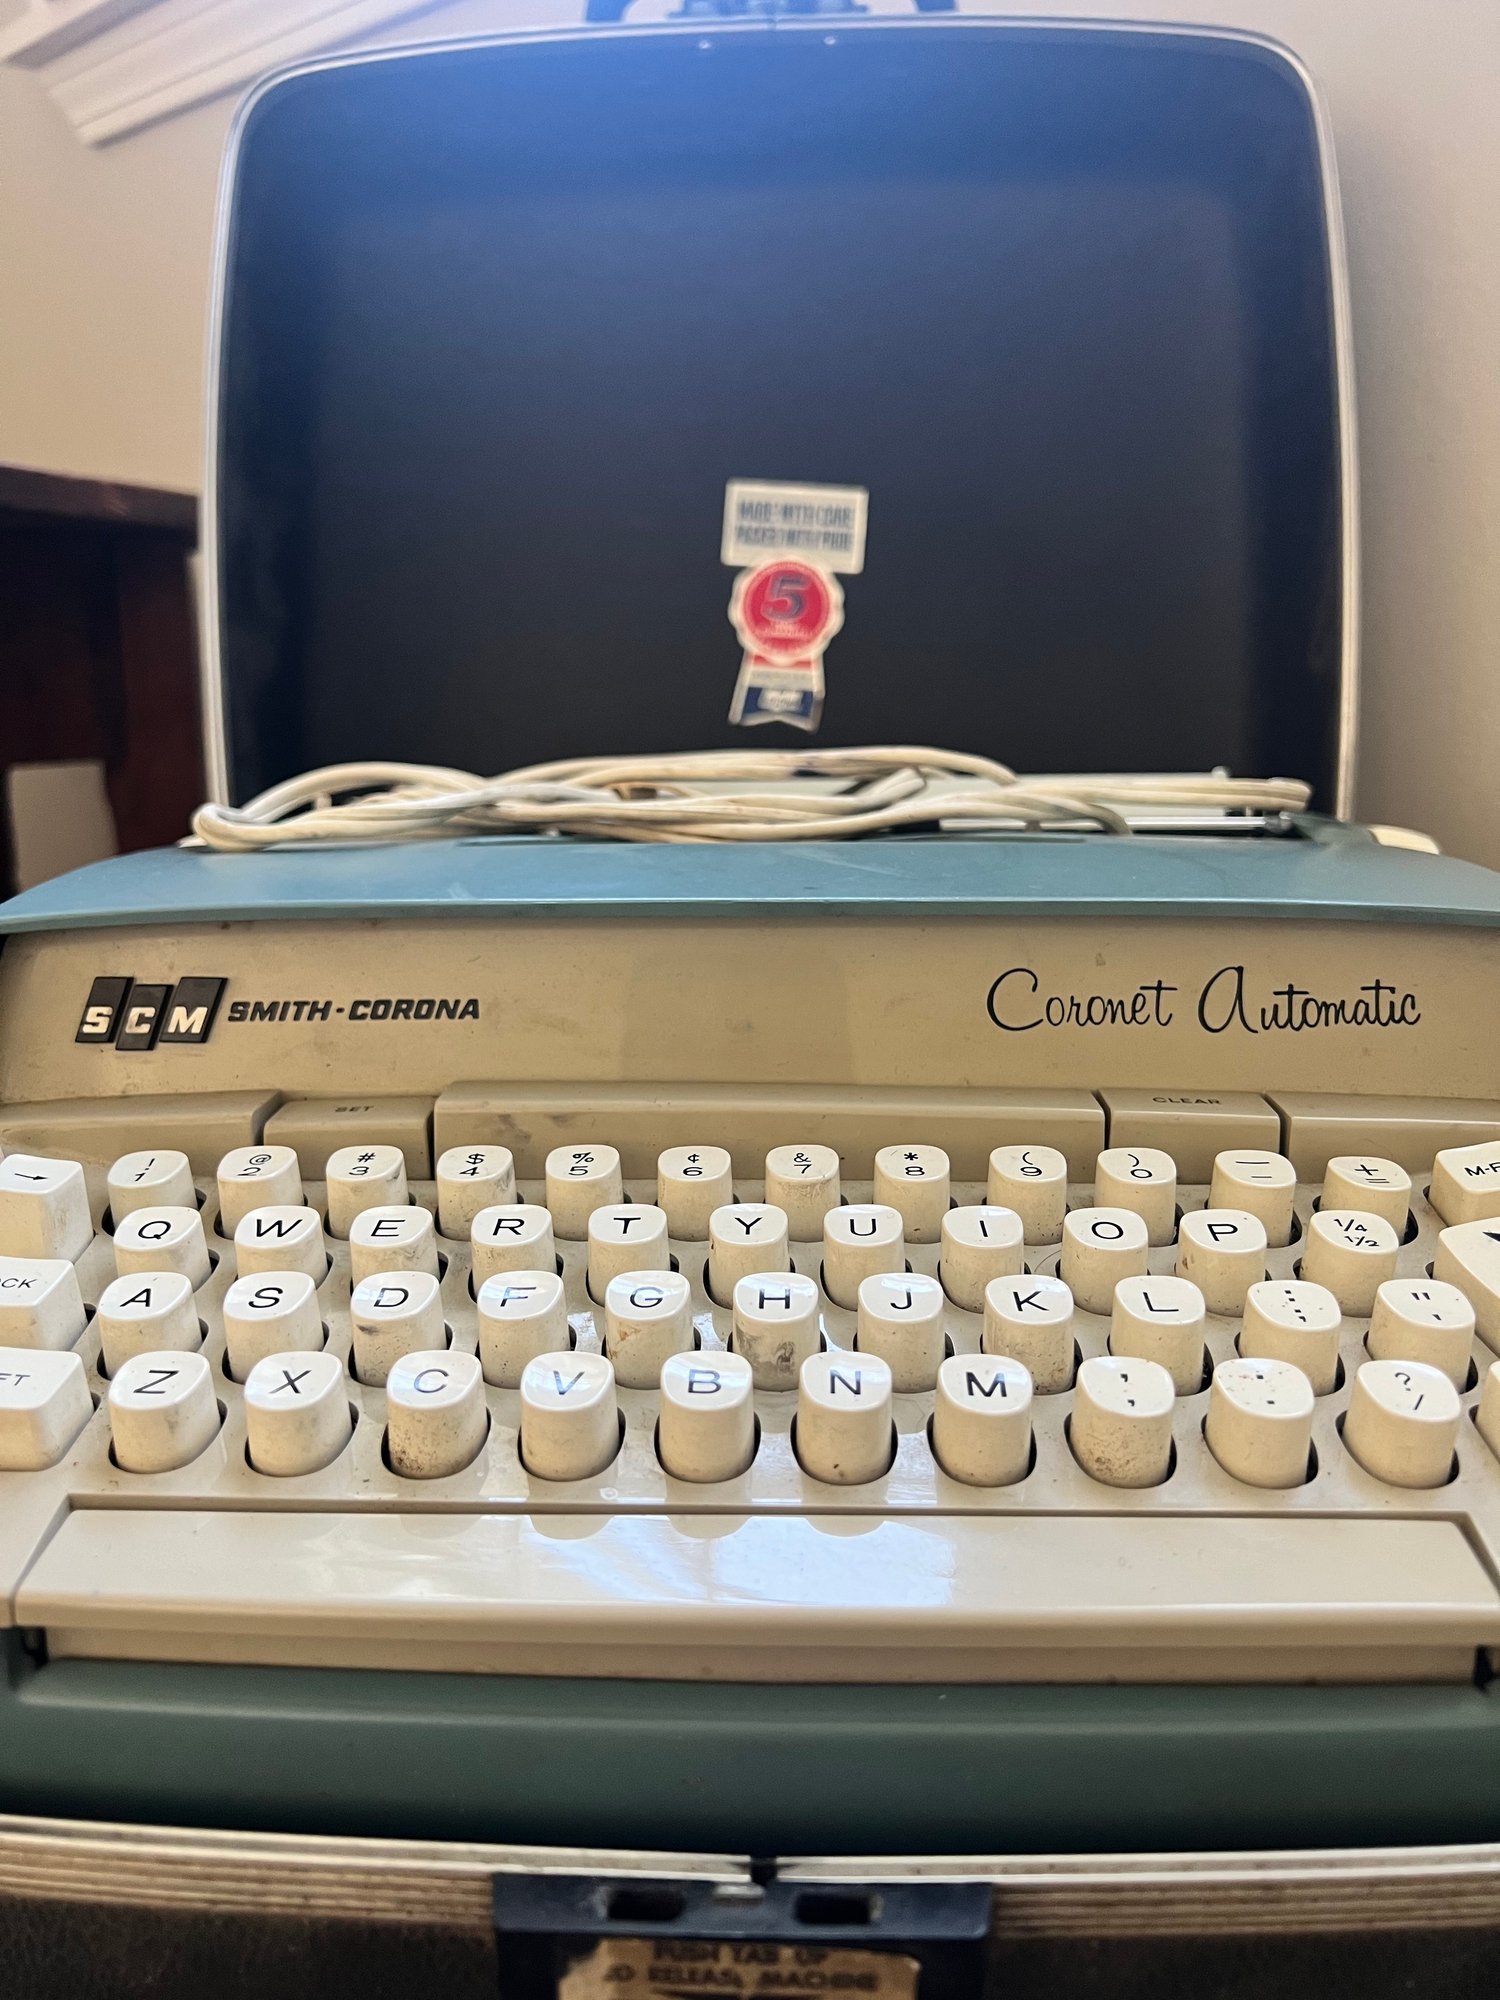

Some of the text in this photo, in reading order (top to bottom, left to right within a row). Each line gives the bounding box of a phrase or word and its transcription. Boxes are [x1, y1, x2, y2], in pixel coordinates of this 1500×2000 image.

[761, 572, 808, 622] 5
[987, 966, 1421, 1033] Coronet Automatic
[82, 999, 479, 1034] SCM SMITH-CORONA
[335, 1105, 374, 1113] SET
[1152, 1097, 1222, 1105] CLEAR
[144, 1158, 156, 1171] !
[248, 1153, 272, 1166] @
[357, 1152, 376, 1163] #
[465, 1152, 486, 1165] $
[572, 1152, 595, 1165] %
[687, 1153, 700, 1164] ¢
[793, 1152, 812, 1163] &
[134, 1172, 146, 1182] 1
[238, 1166, 262, 1177] 2
[348, 1166, 370, 1176] 3
[459, 1166, 479, 1177] 4
[568, 1165, 589, 1176] 5
[682, 1166, 703, 1177] 6
[796, 1163, 812, 1175] 7
[904, 1165, 926, 1177] 8
[1019, 1166, 1043, 1177] 9
[1354, 1164, 1379, 1176] +
[138, 1221, 171, 1239] Q
[257, 1219, 302, 1237] W
[371, 1220, 405, 1237] E
[493, 1219, 524, 1235] R
[614, 1218, 641, 1234] T
[735, 1218, 762, 1235] Y
[850, 1219, 876, 1236] U
[980, 1221, 988, 1237] I
[1092, 1222, 1123, 1239] O
[1207, 1224, 1238, 1241] P
[0, 1278, 37, 1289] CK
[120, 1289, 151, 1307] A
[249, 1288, 283, 1308] S
[374, 1288, 408, 1307] D
[501, 1287, 536, 1307] F
[630, 1287, 663, 1308] G
[758, 1288, 791, 1310] H
[890, 1288, 913, 1310] J
[1013, 1291, 1048, 1311] K
[1143, 1292, 1179, 1312] L
[134, 1370, 178, 1393] Z
[270, 1370, 311, 1394] X
[413, 1369, 449, 1393] C
[553, 1370, 585, 1395] V
[687, 1369, 722, 1394] B
[829, 1370, 862, 1395] N
[966, 1371, 1008, 1398] M
[1394, 1372, 1411, 1392] ?
[648, 1967, 743, 1988] RELEAS
